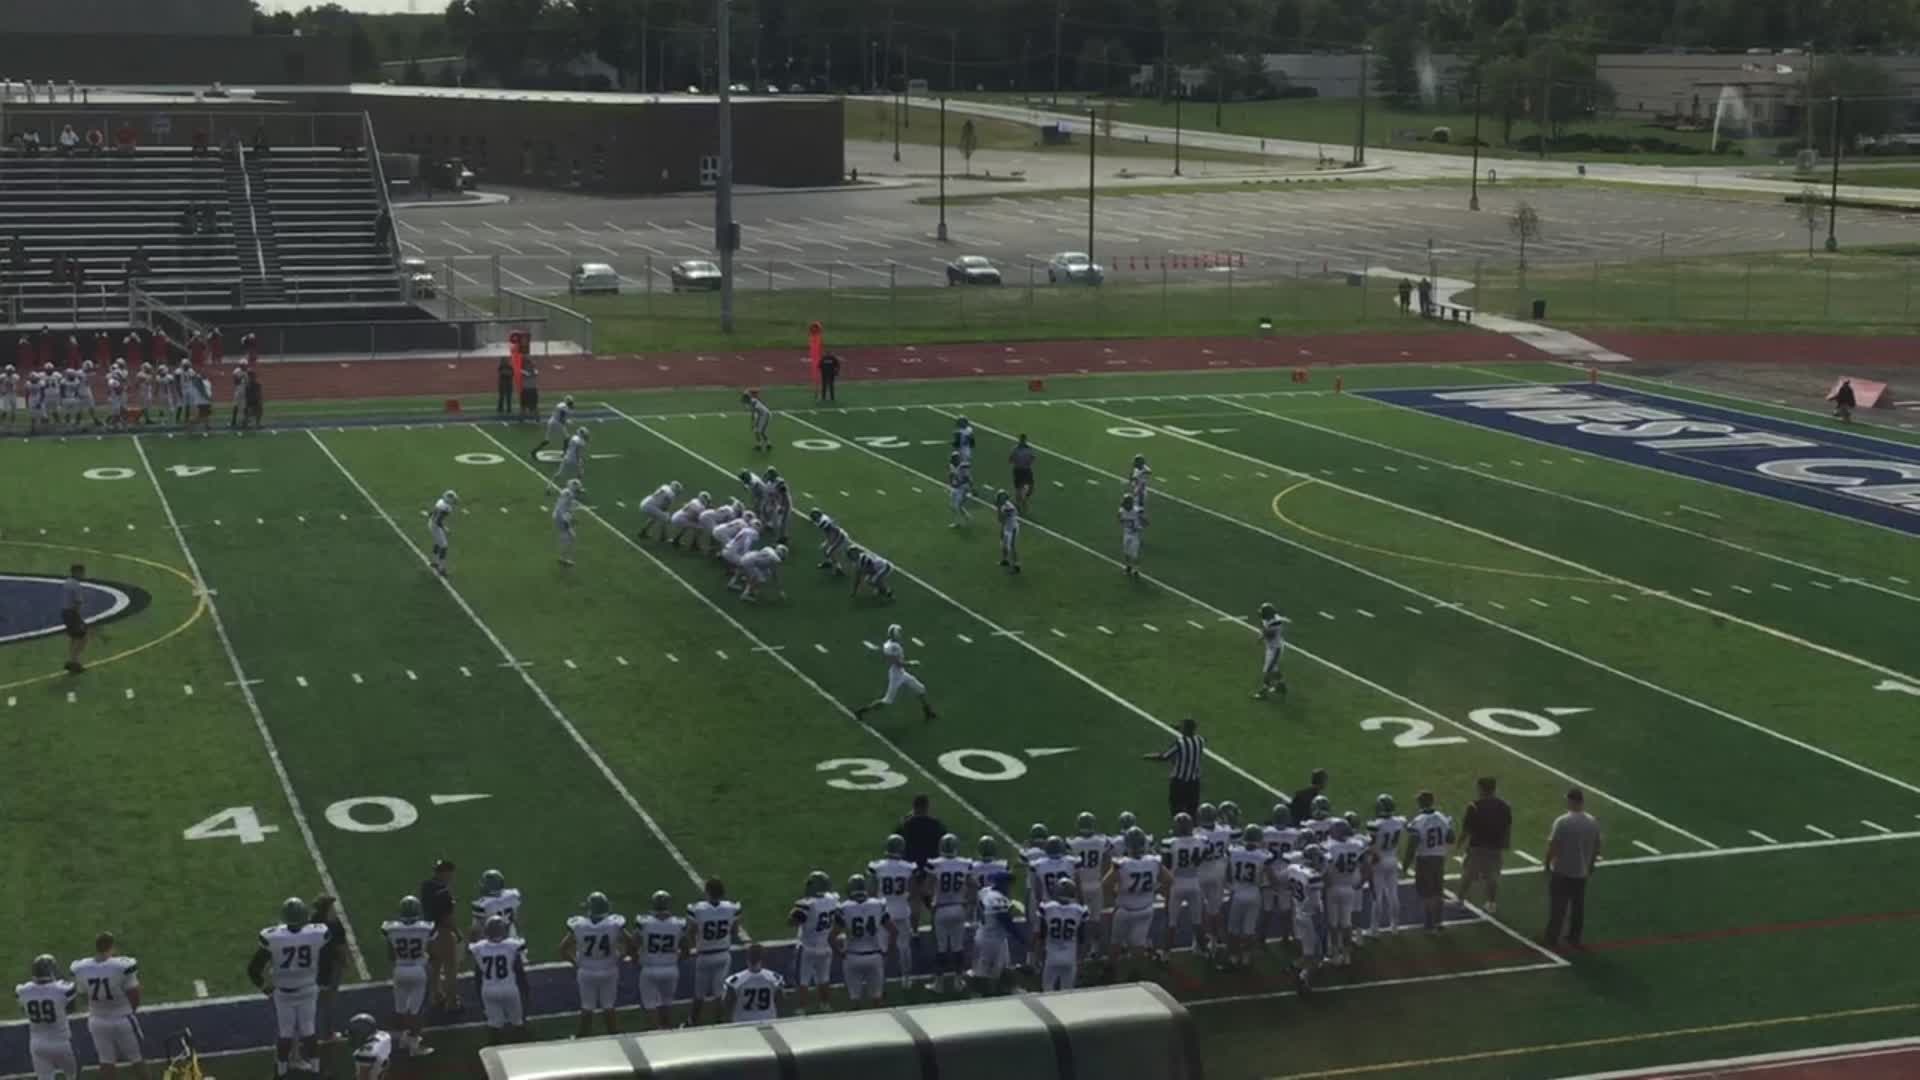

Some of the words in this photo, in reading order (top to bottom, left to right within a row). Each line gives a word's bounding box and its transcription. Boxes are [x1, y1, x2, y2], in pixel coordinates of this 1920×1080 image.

[881, 876, 907, 896] 83
[1128, 871, 1153, 893] 72
[851, 915, 878, 938] 64
[1049, 917, 1077, 939] 26
[279, 944, 313, 969] 79
[395, 937, 423, 960] 22
[583, 932, 612, 958] 74
[482, 955, 509, 980] 78
[87, 977, 114, 1001] 71
[26, 999, 57, 1024] 99
